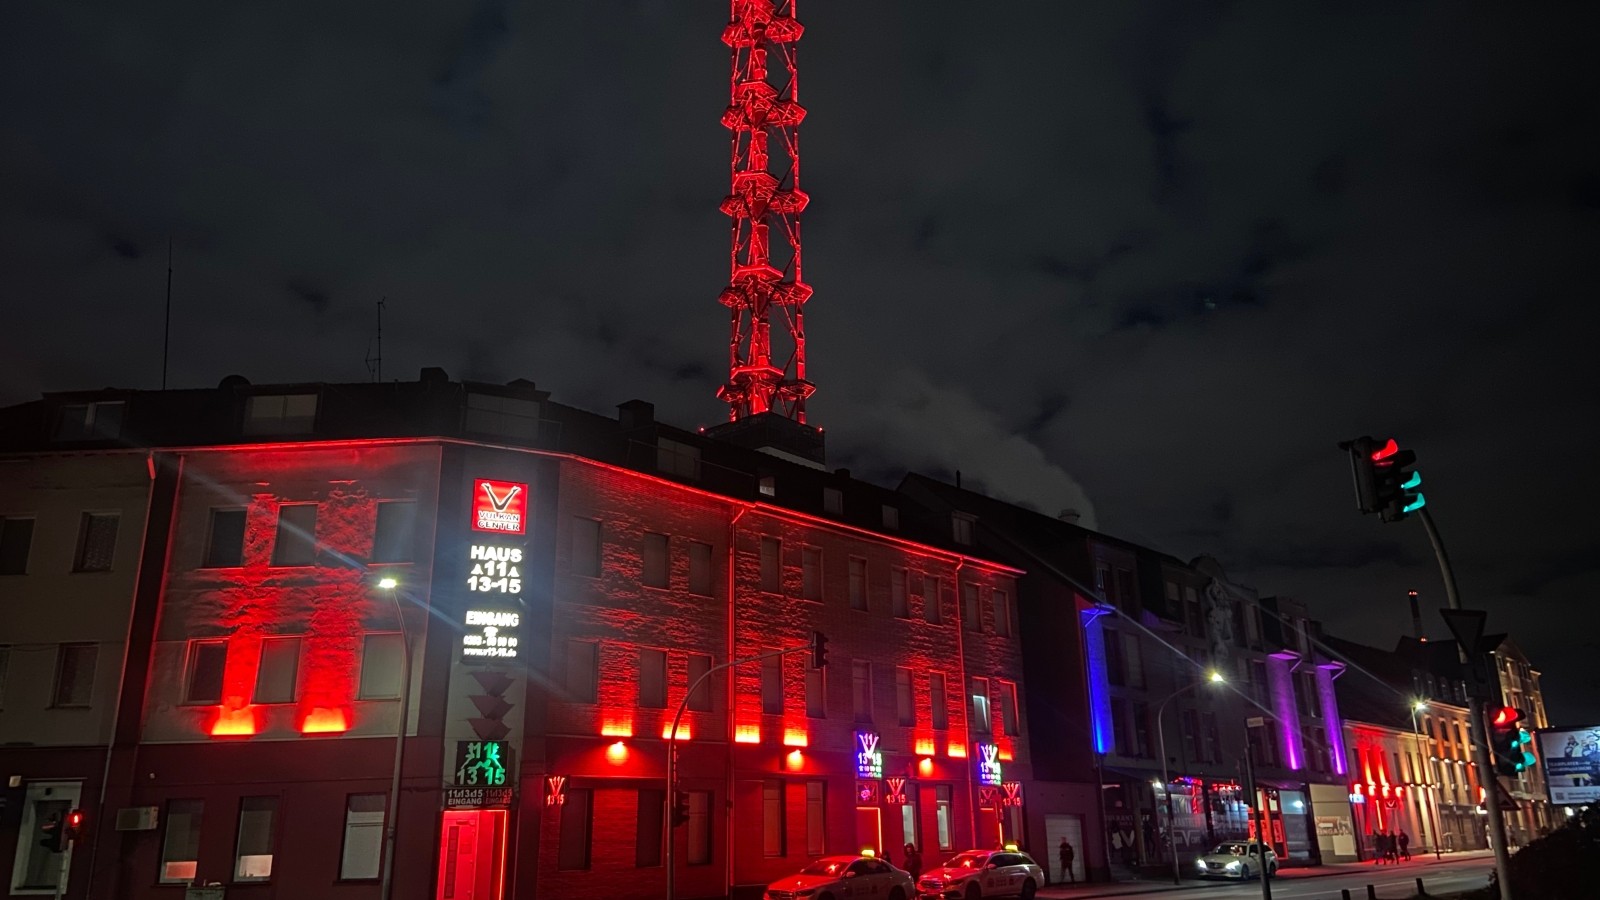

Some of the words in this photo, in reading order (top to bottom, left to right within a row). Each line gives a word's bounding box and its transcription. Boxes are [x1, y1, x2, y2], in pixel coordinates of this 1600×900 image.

[478, 510, 520, 522] VULKAN
[478, 521, 520, 531] CENTER
[470, 545, 522, 562] HAUS
[484, 561, 507, 577] 11
[467, 575, 521, 594] 13-15
[465, 610, 519, 627] EINGANG
[457, 768, 478, 785] 13
[485, 767, 505, 785] 15
[448, 797, 482, 805] EINGANG
[897, 794, 906, 803] 15
